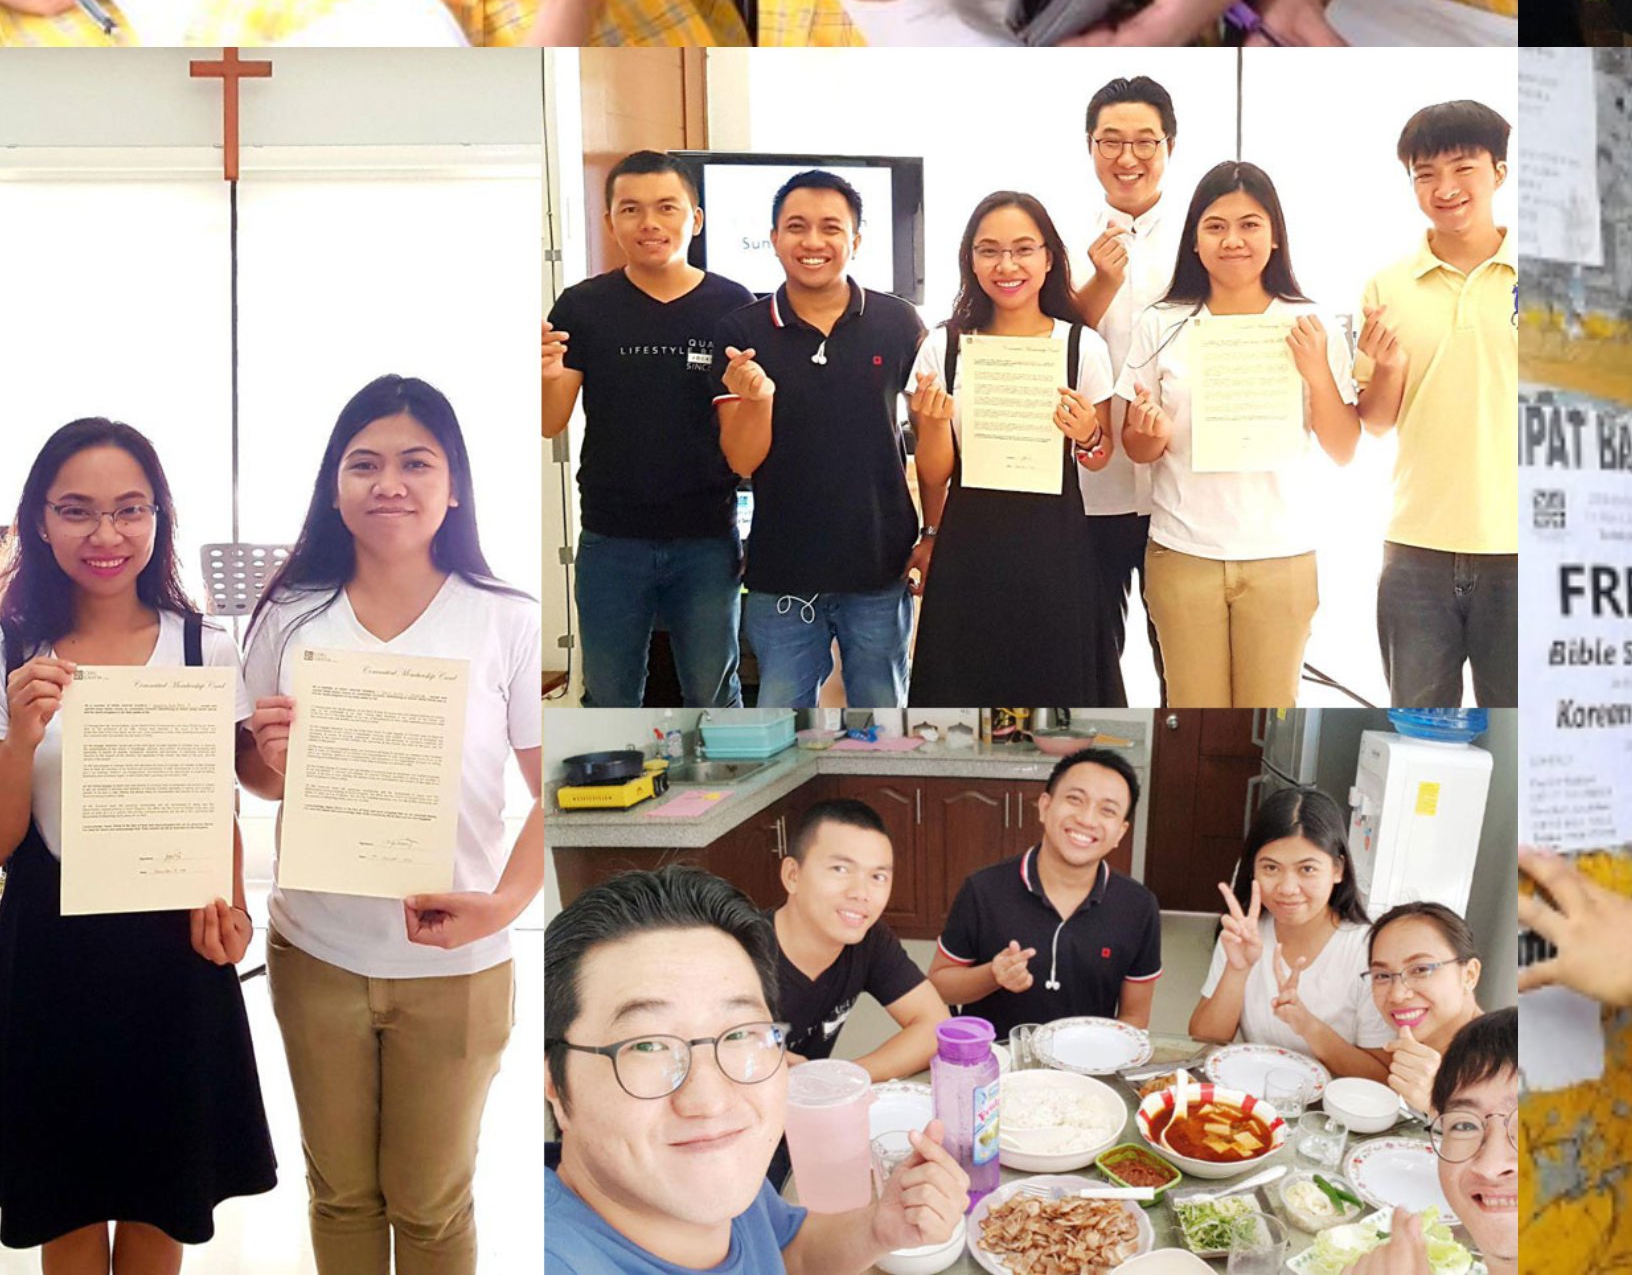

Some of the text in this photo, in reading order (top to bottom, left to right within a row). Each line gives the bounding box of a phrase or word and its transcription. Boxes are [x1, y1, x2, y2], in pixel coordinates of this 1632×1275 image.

[742, 236, 772, 251] Sun
[688, 338, 714, 348] QUA
[1548, 637, 1617, 667] Bible
[1556, 698, 1632, 729] Korean
